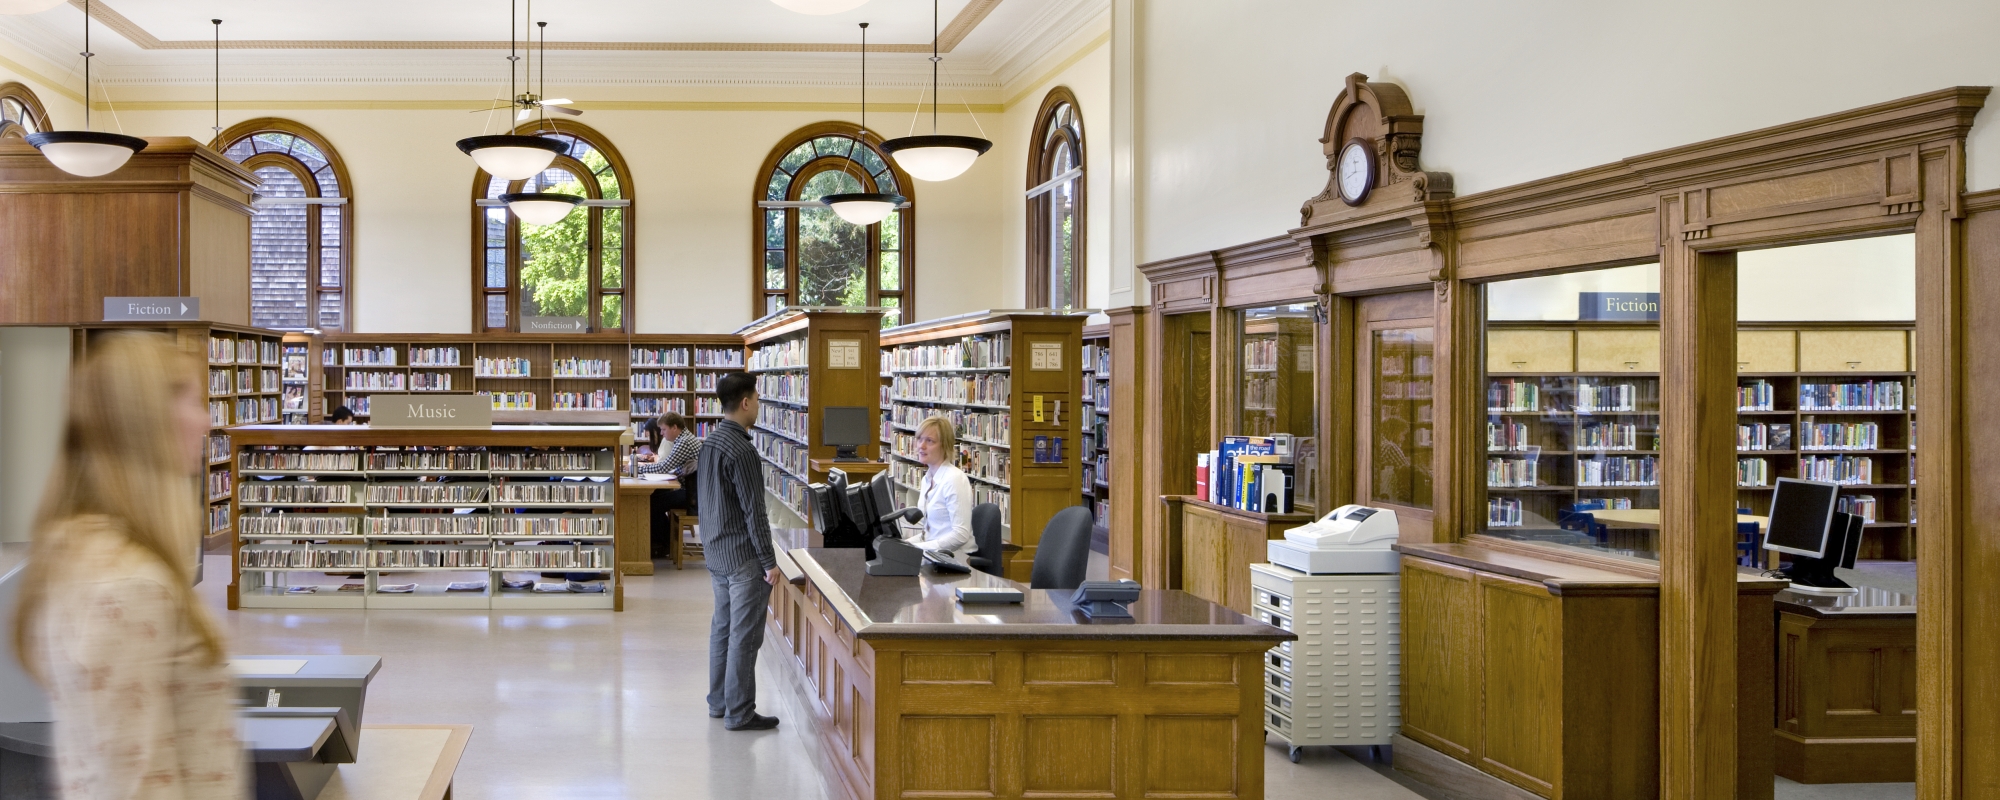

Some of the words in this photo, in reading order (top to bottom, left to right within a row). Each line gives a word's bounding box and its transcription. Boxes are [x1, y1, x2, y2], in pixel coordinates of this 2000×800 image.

[127, 302, 171, 315] Fiction
[1606, 297, 1657, 312] Fiction
[531, 320, 573, 330] Nonfiction
[407, 403, 456, 419] Music
